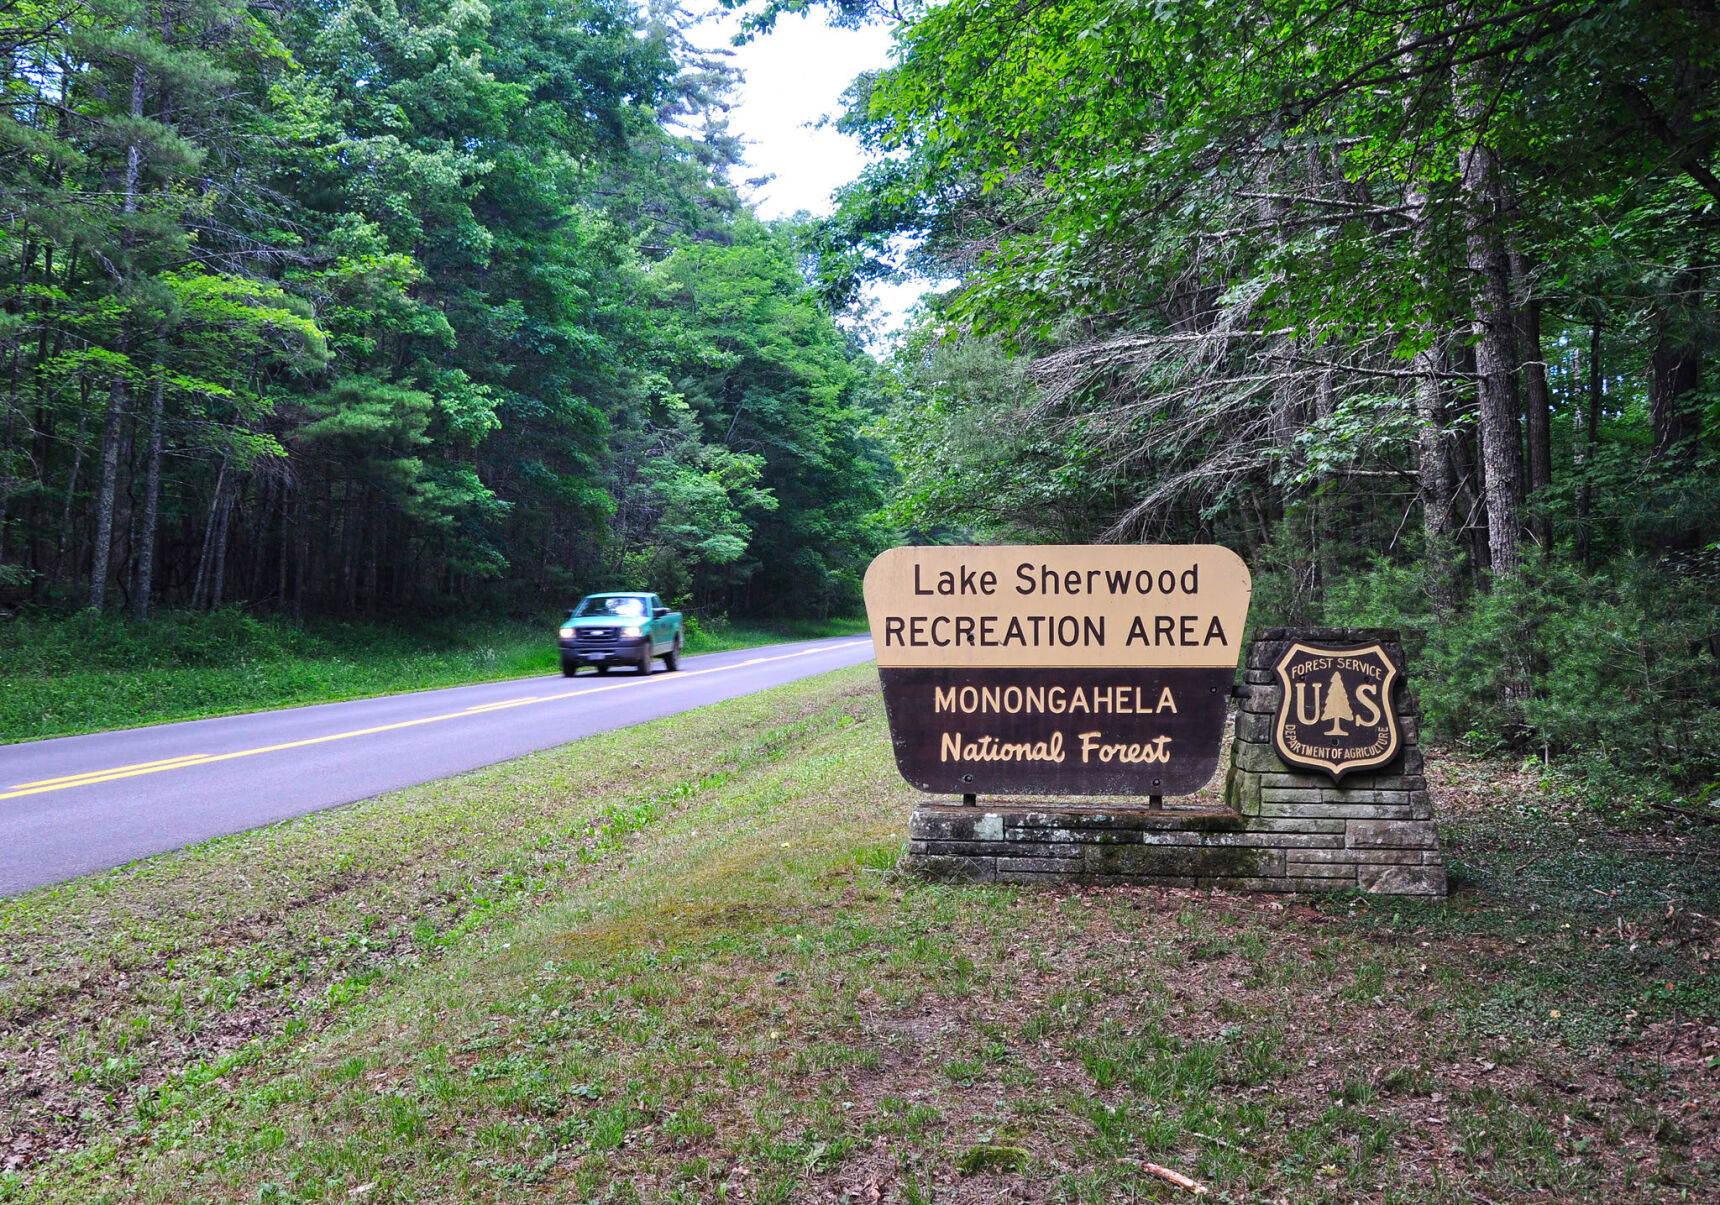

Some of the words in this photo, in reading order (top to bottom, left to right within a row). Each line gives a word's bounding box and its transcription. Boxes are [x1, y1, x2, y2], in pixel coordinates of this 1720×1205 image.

[914, 563, 997, 595] Lake
[1015, 562, 1198, 595] Sherwood
[885, 616, 1105, 647] RECREATION
[1125, 616, 1228, 647] AREA
[1291, 657, 1333, 679] FOREST
[1336, 657, 1382, 680] SERVICE
[934, 686, 1177, 714] MONONGAHELA
[940, 731, 1065, 763] National
[1078, 731, 1172, 764] Forest
[1285, 724, 1330, 759] DEPARTMENT
[1331, 748, 1342, 759] OF
[1343, 726, 1389, 759] AGRICULTURE
